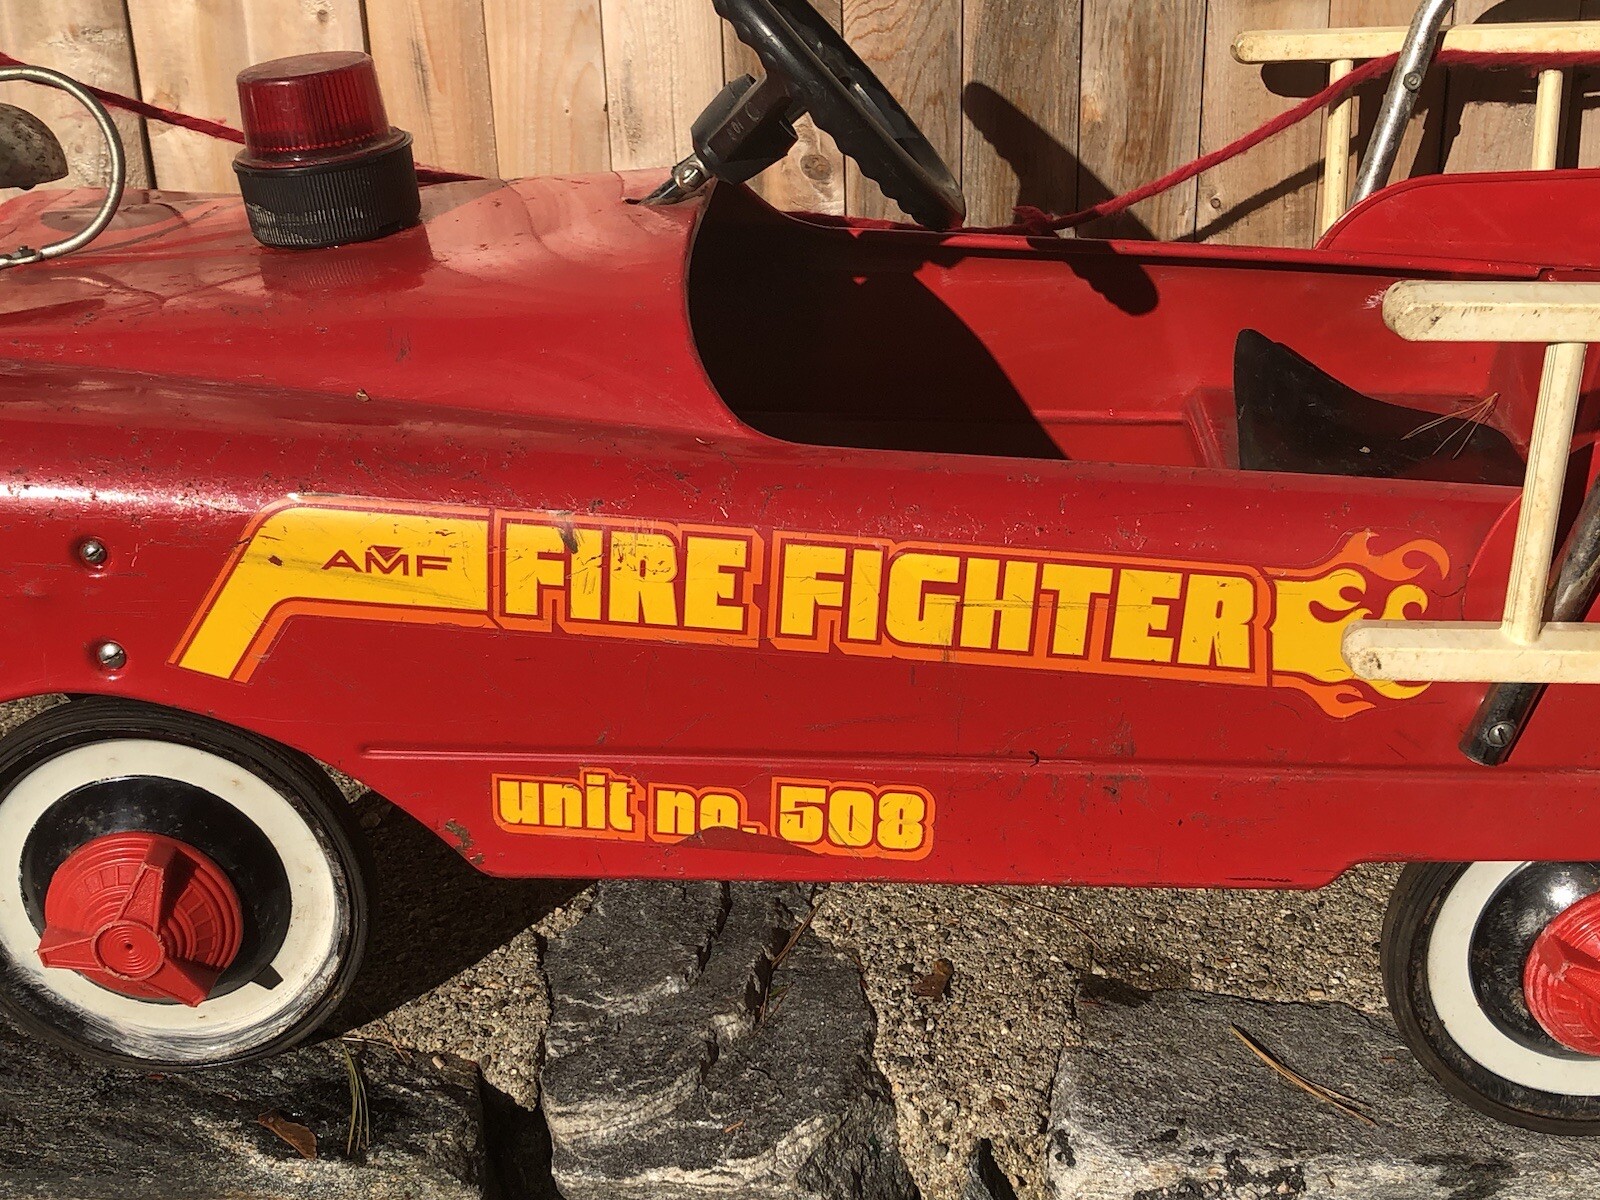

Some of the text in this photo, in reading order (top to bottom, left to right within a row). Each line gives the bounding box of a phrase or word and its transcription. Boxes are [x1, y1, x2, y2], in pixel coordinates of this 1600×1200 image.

[321, 545, 453, 577] AMF
[505, 523, 1254, 669] FIRE FIGHTER
[500, 774, 634, 832] unit
[779, 785, 925, 850] 508
